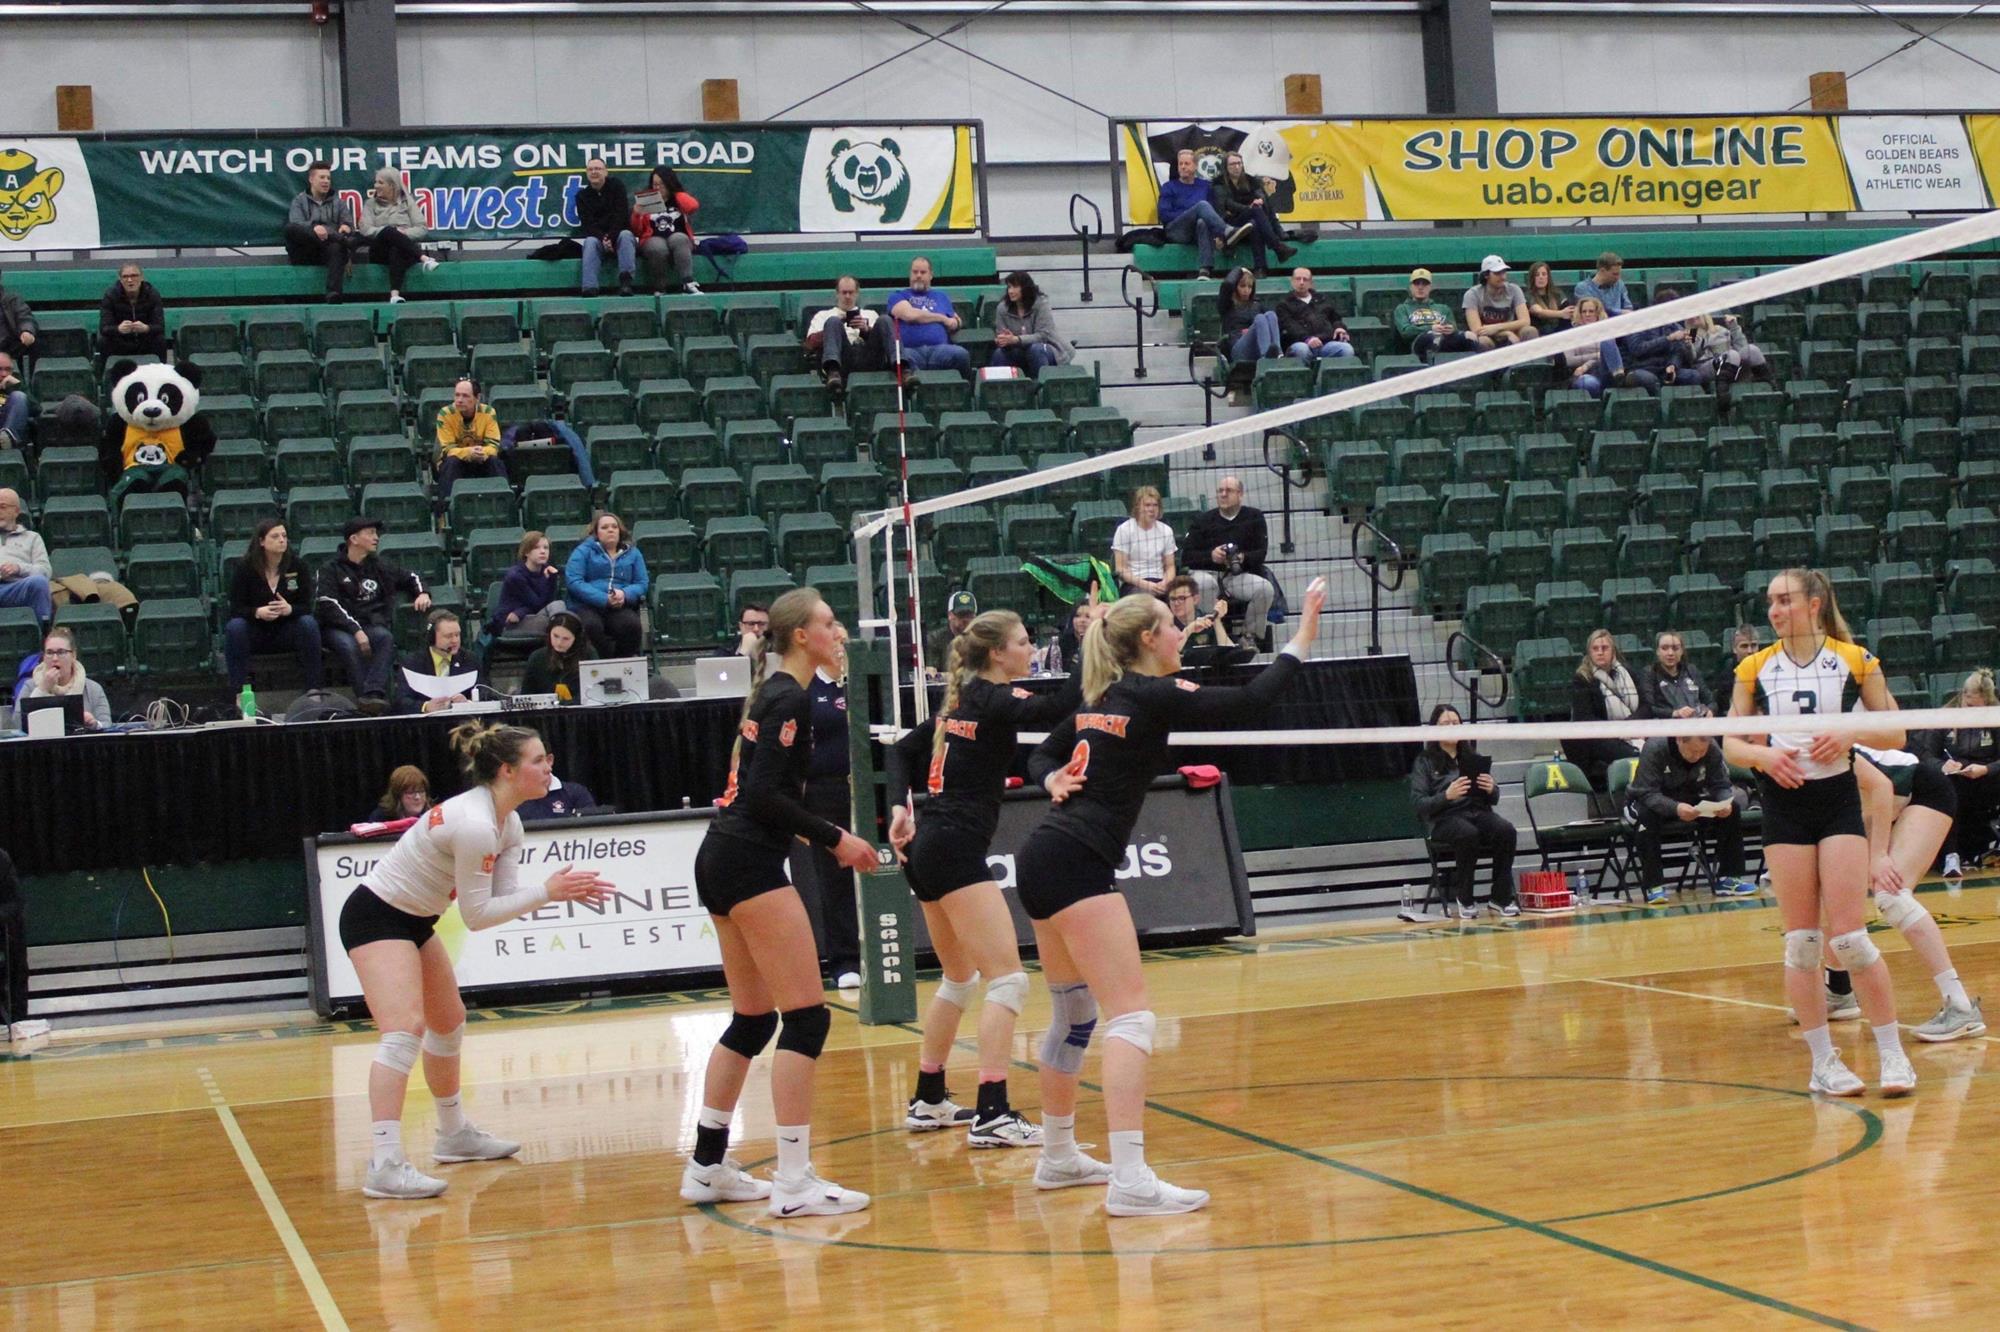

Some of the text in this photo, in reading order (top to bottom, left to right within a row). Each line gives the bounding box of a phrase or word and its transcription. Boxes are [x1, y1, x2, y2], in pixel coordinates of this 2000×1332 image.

[1403, 124, 1807, 172] SHOP ONLINE
[1882, 134, 1938, 146] OFFICIAL
[139, 140, 755, 174] WATCH OUR TEAMS ON THE ROAD
[1865, 148, 1960, 161] GOLDEN BEARS
[5, 174, 19, 189] A
[1882, 163, 1943, 175] & PANDAS
[1482, 174, 1762, 208] uab.ca/fangear
[1865, 177, 1961, 190] ATHLETIC WEAR
[1546, 764, 1569, 790] A
[543, 838, 646, 864] Athletes
[495, 920, 716, 956] REAL ESTA
